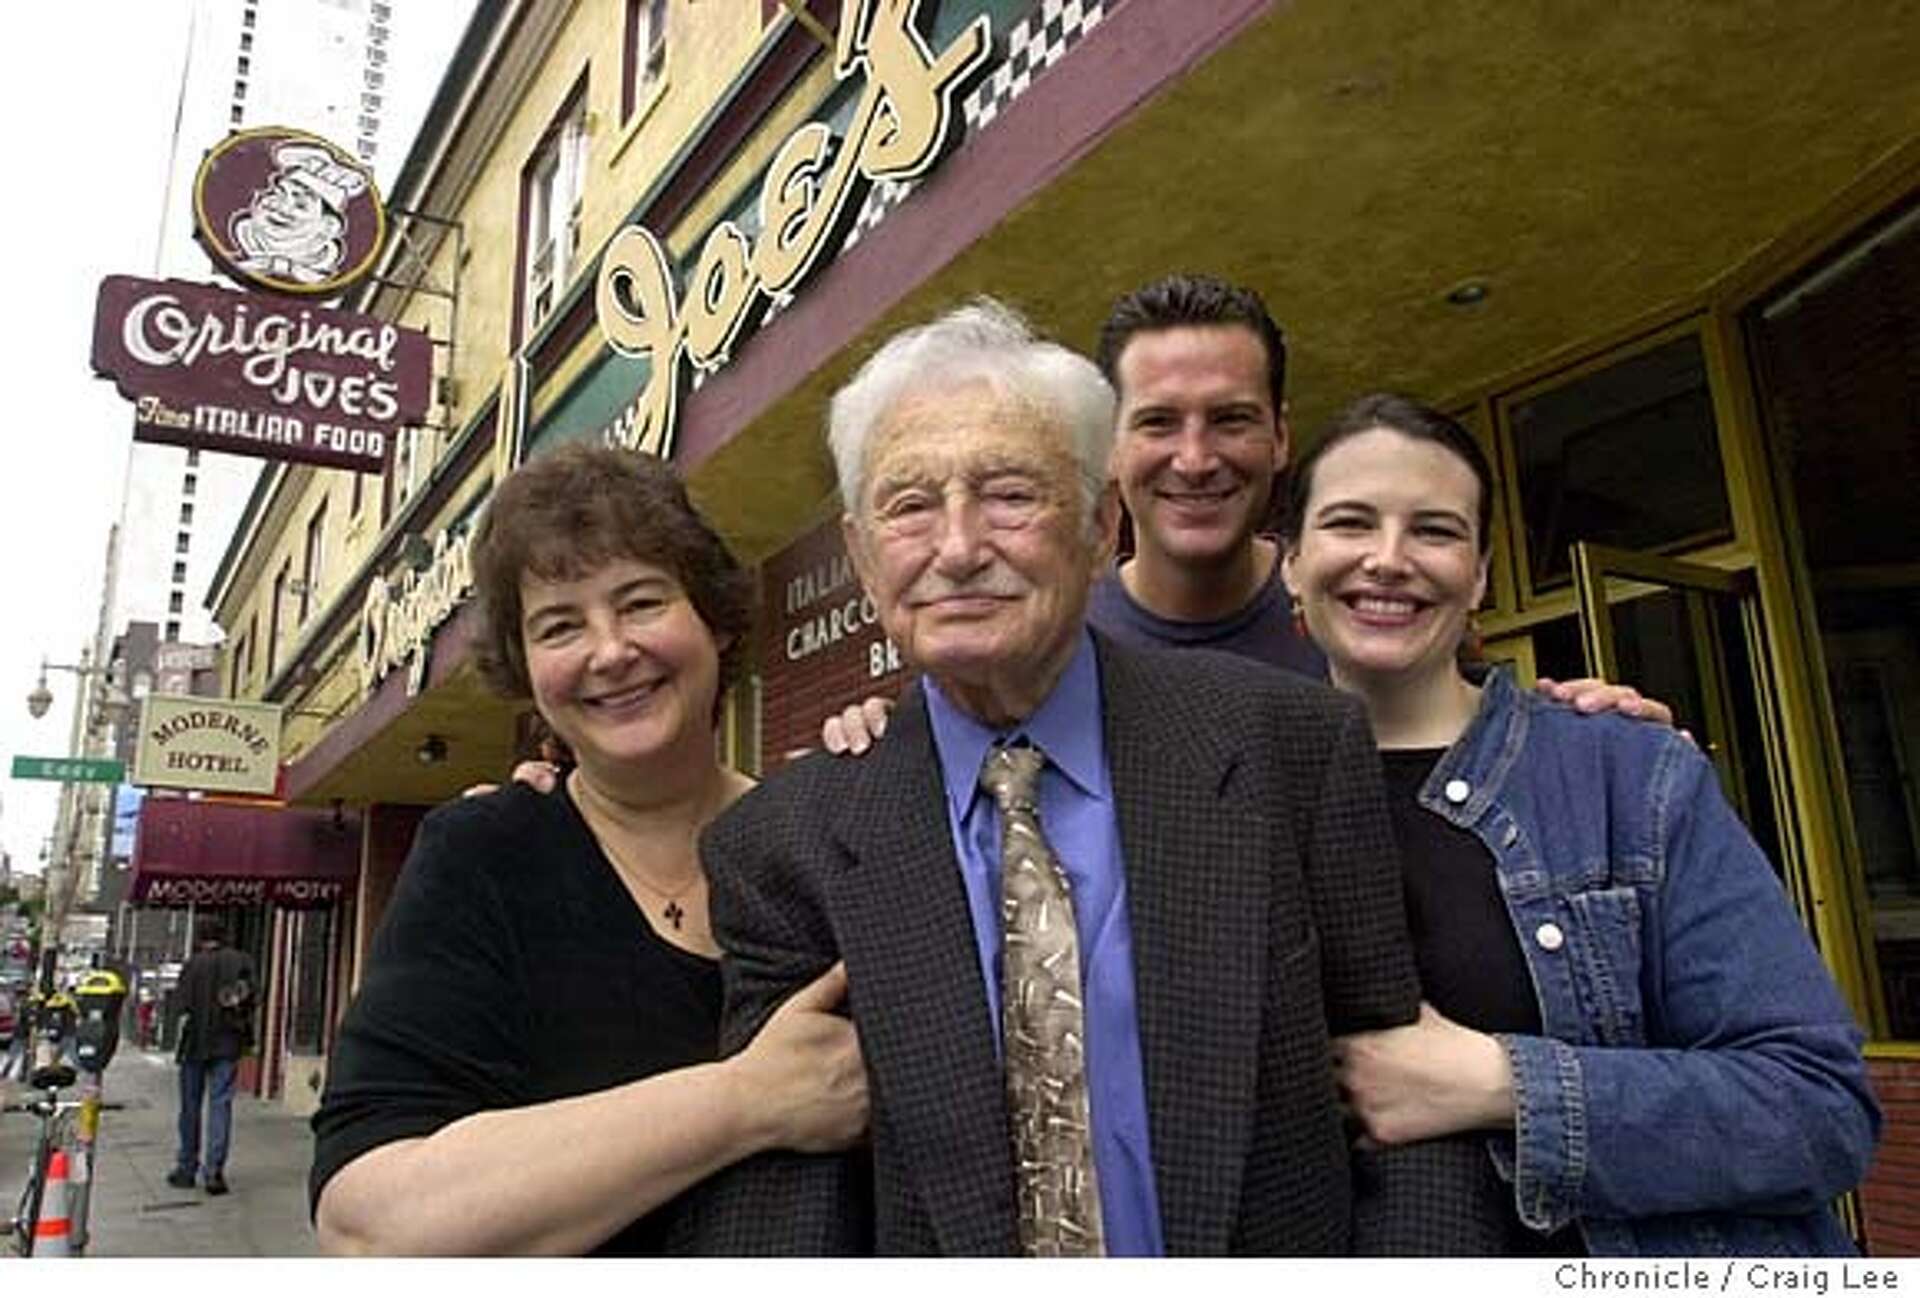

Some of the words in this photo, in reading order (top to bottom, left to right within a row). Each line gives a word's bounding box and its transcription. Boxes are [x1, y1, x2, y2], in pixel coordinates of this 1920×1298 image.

[123, 294, 398, 386] Original
[272, 366, 398, 419] JOE'S
[195, 405, 303, 446] ITALIAN
[314, 424, 384, 458] FOOD
[787, 555, 853, 614] ITALIA
[787, 596, 879, 660] CHARCO
[152, 711, 269, 755] MODERNE
[167, 751, 249, 773] HOTEL
